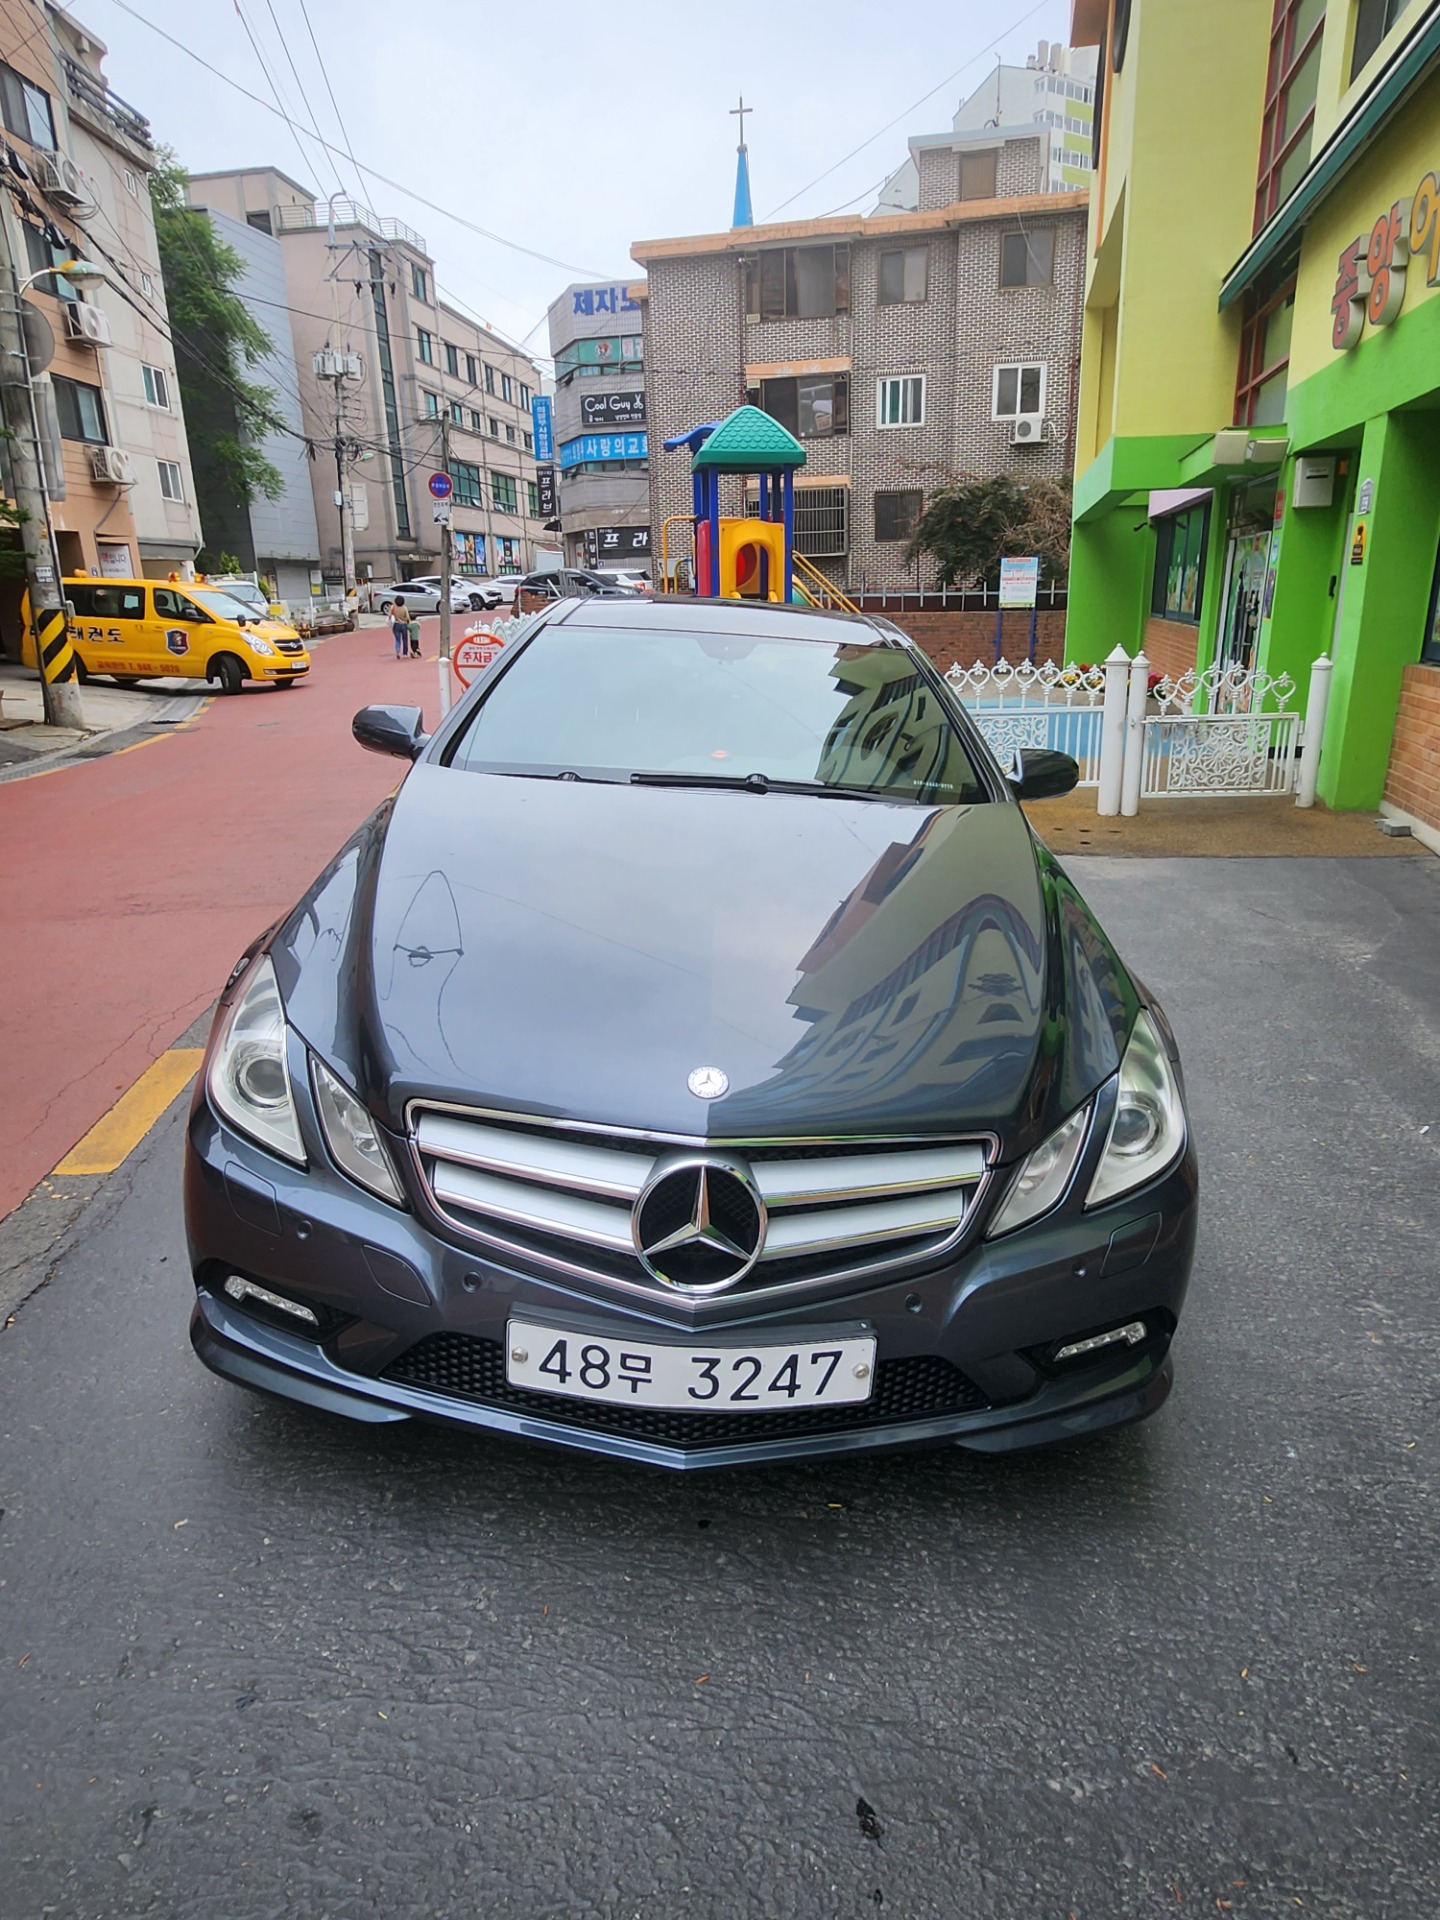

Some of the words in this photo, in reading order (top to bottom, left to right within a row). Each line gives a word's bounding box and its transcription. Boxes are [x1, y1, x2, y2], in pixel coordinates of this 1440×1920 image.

[585, 397, 607, 412] Cool
[609, 395, 631, 410] Guy
[538, 1338, 653, 1394] 48무
[687, 1349, 843, 1401] 3247
